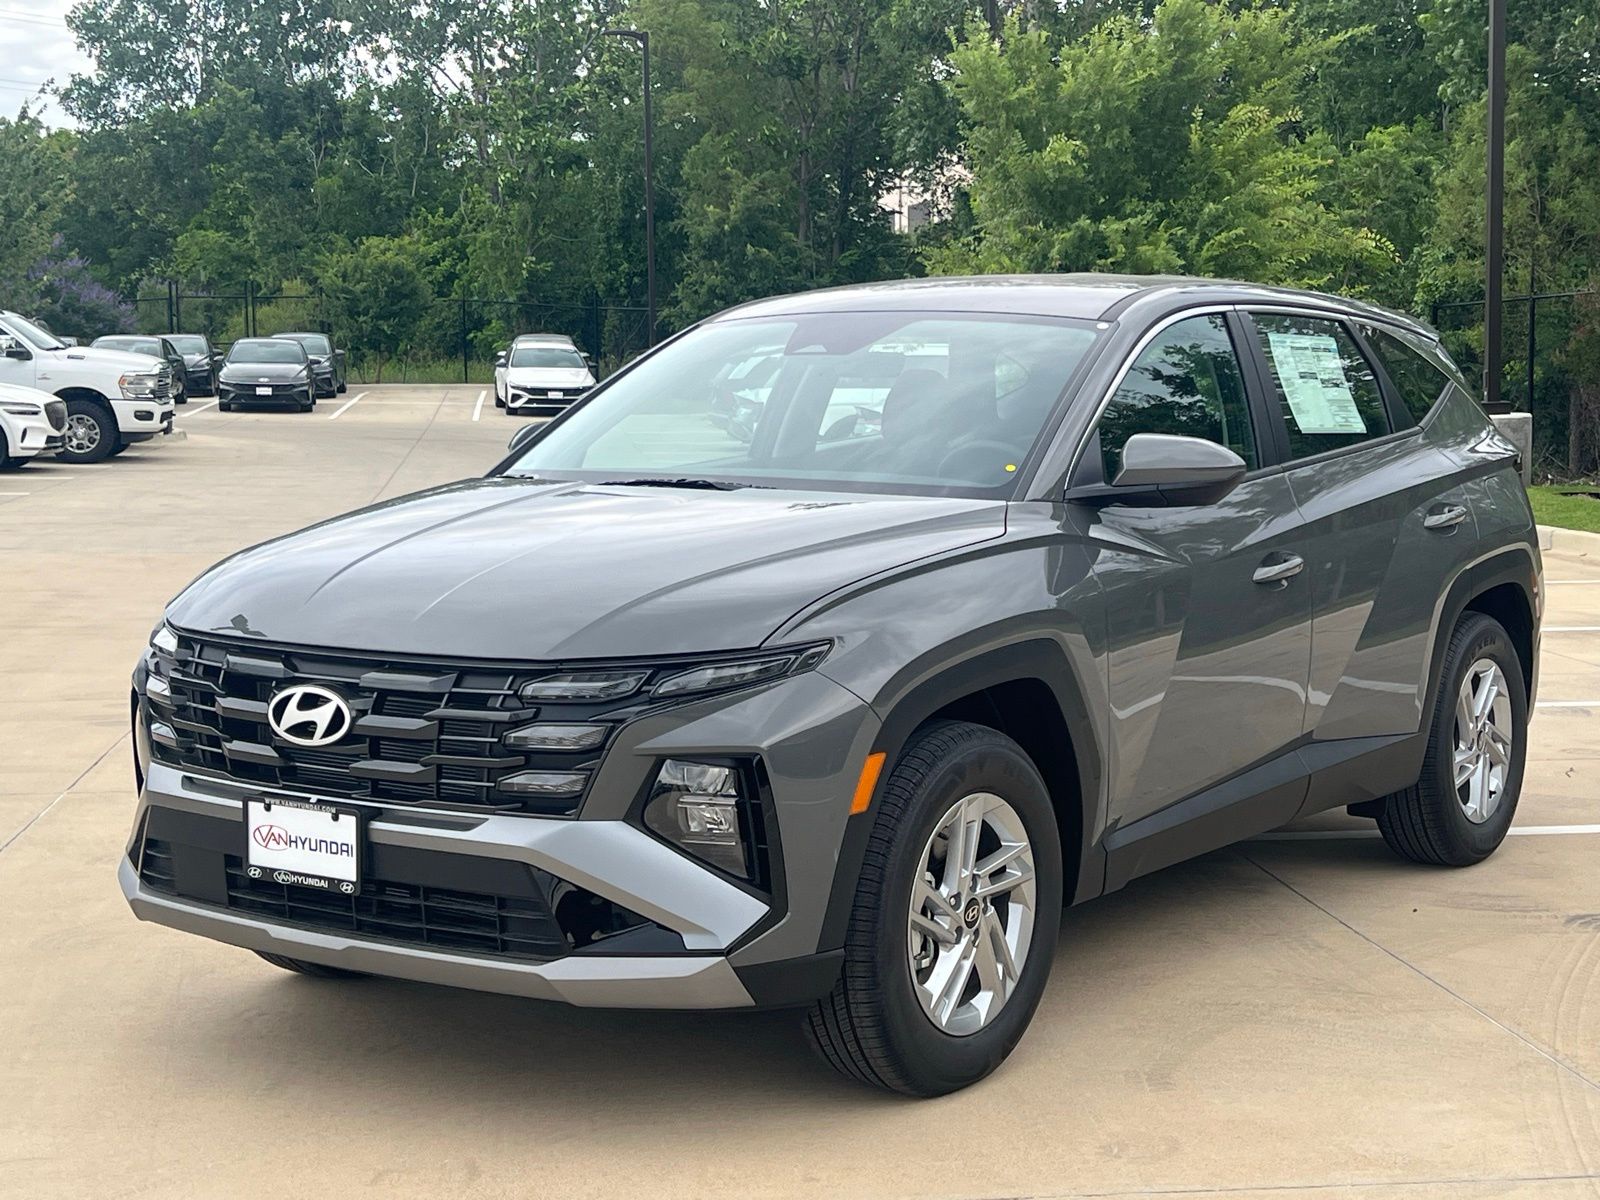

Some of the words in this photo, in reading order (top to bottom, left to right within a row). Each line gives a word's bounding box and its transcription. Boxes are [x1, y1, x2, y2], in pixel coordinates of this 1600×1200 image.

[264, 797, 337, 814] WWW.VANHYUNDAI.COM
[288, 834, 354, 858] HYUNDAI
[291, 875, 329, 889] HYUNDAI
